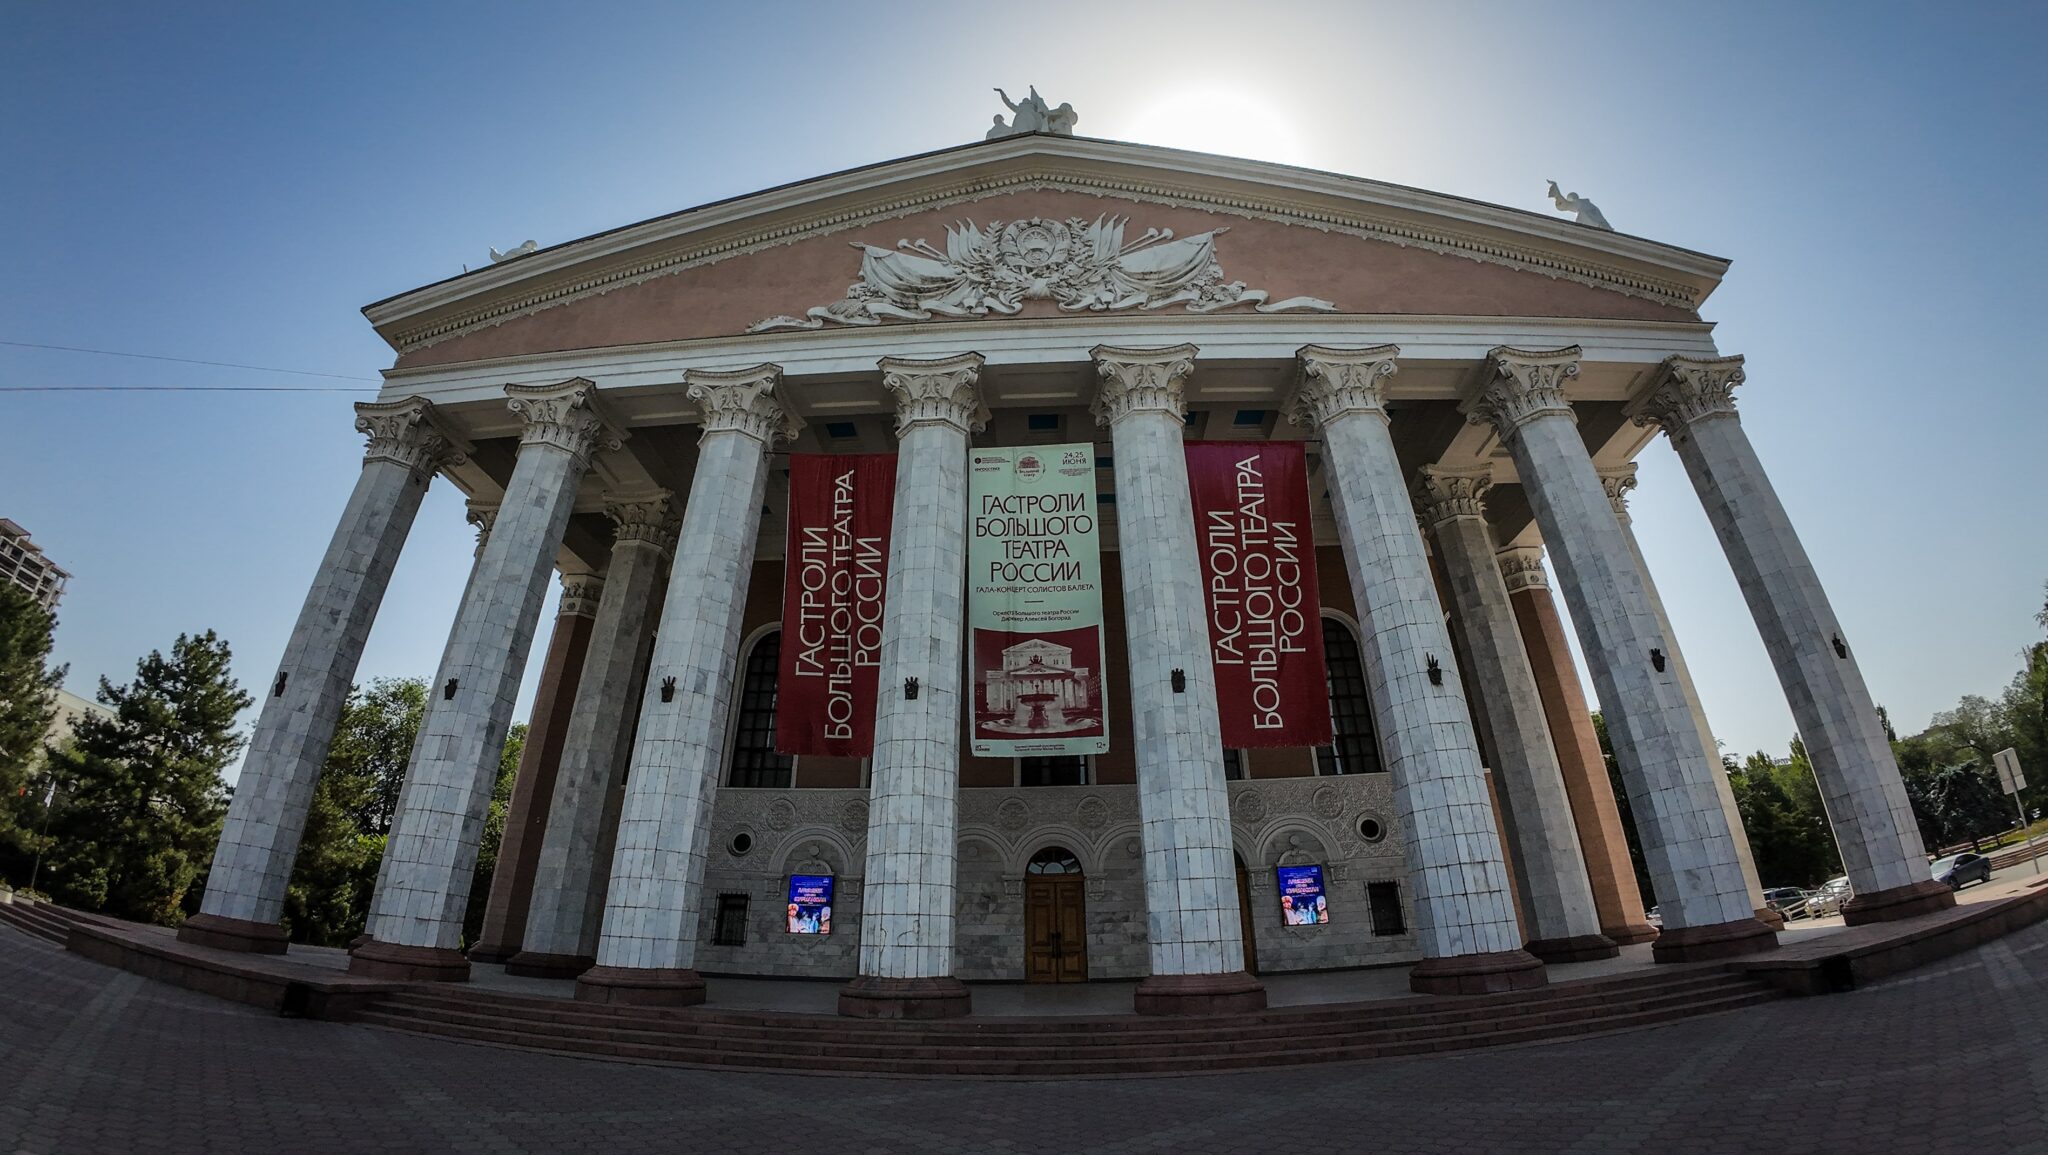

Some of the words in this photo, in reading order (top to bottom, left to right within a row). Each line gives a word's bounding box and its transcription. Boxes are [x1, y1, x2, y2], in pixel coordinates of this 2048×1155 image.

[982, 493, 1085, 515] ГАСТРОЛИ
[1062, 457, 1087, 465] ИЮНЯ
[1236, 454, 1269, 550] ТЕАТРА
[832, 469, 855, 567] ТЕАТРА
[976, 515, 1093, 537] БОЛЬШОГО
[1001, 539, 1070, 559] ТЕАТРА
[795, 527, 828, 677] ГАСТРОЛИ
[855, 537, 883, 667] РОССИИ
[976, 584, 1027, 594] ГАЛА-КОНЦЕРТ
[1027, 583, 1067, 594] СОЛИСТОВ
[1067, 582, 1095, 592] БАЛЕТА
[990, 561, 1081, 583] РОССИИ
[1207, 510, 1244, 664] ГАСТРОЛИ
[1272, 522, 1306, 653] РОССИИ
[824, 569, 853, 739] БОЛЬШОГО
[1243, 553, 1284, 729] БОЛЬШОГО
[1096, 741, 1106, 749] 12+
